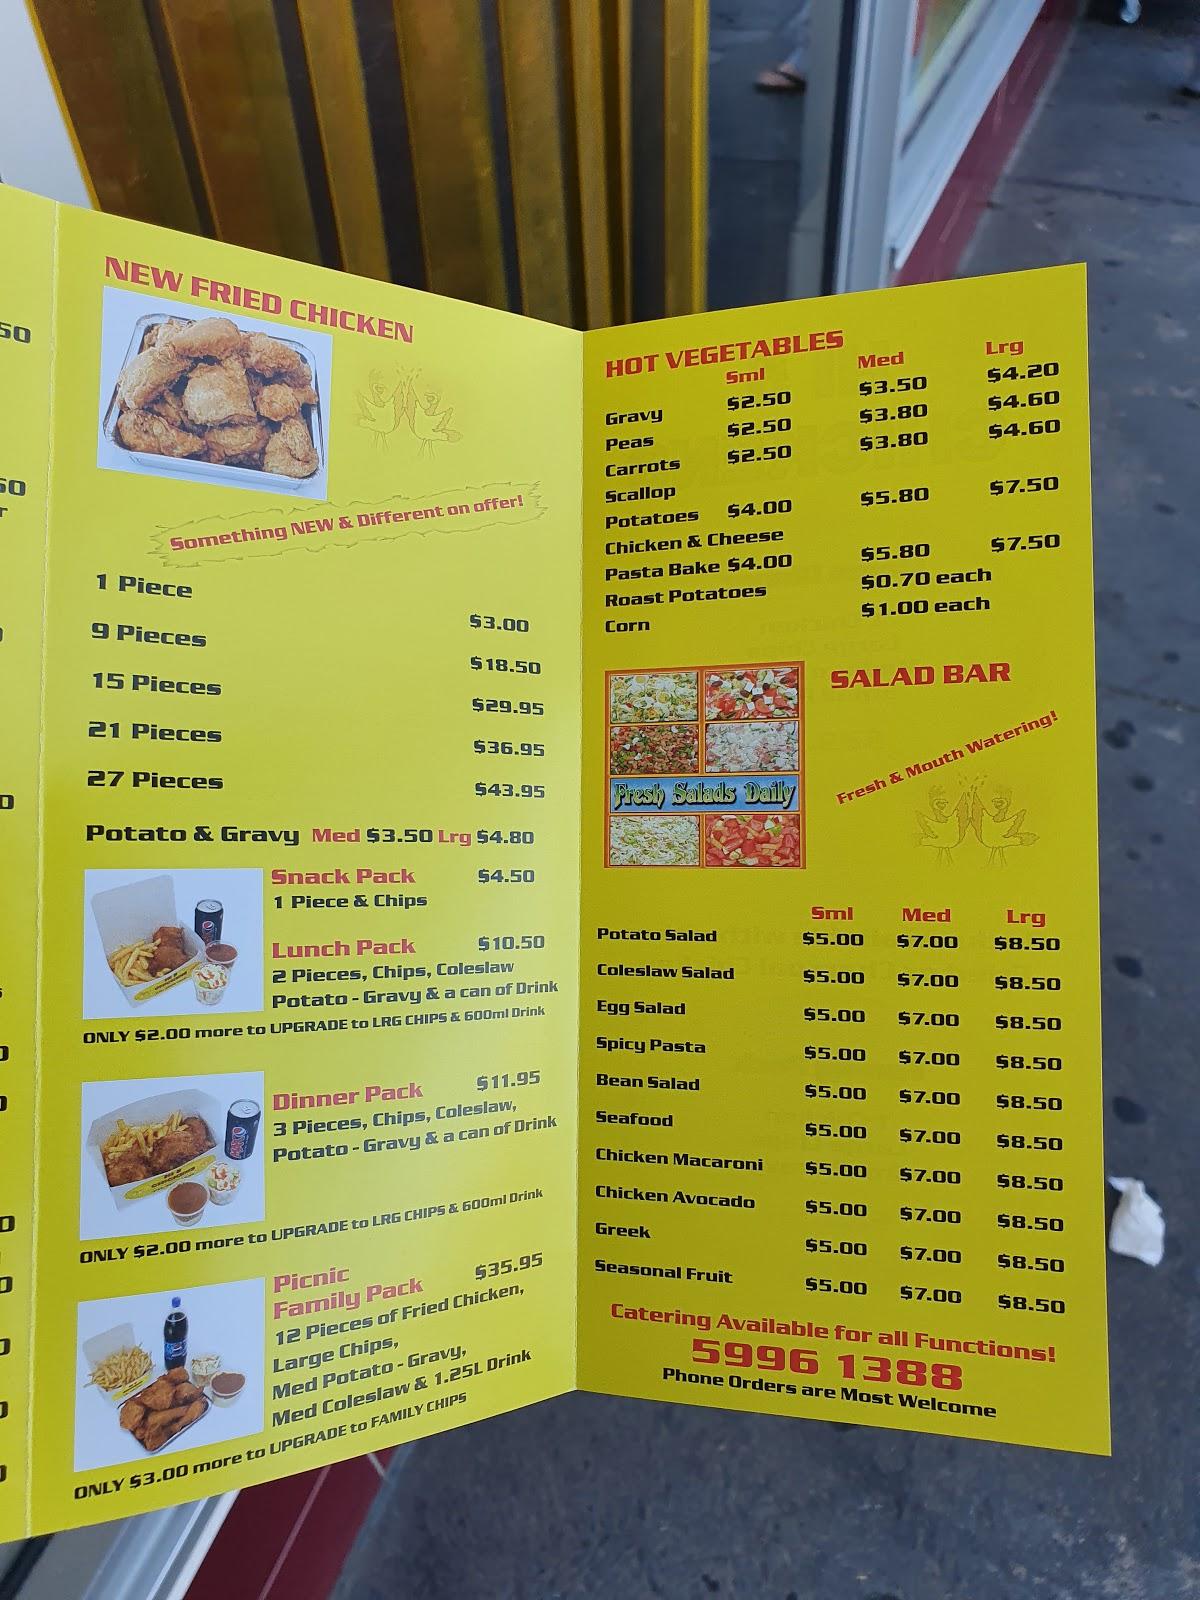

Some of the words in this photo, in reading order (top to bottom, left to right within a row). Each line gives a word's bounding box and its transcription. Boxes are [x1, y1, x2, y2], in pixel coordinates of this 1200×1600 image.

[105, 255, 184, 293] NEW
[190, 275, 282, 315] FRIED
[289, 299, 414, 344] CHICKEN
[606, 353, 660, 379] HOT
[664, 329, 844, 369] VEGETABLES
[985, 340, 1024, 356] Lrg
[857, 351, 905, 369] Med
[726, 367, 765, 385] Sml
[987, 362, 1060, 384] $4.20
[859, 376, 928, 397] $3.50
[727, 391, 792, 412] $2.50
[605, 409, 663, 426] Gravy
[605, 436, 654, 452] Peas
[605, 459, 681, 478] Carrots
[605, 486, 676, 504] Scallop
[989, 476, 1059, 497] $7.50
[860, 487, 930, 508] $5.80
[727, 499, 793, 519] $4.00
[170, 526, 288, 551] Something
[290, 518, 334, 536] NEW
[338, 516, 354, 530] &
[356, 506, 445, 528] Different
[447, 504, 471, 516] on
[473, 494, 524, 513] offer!
[605, 511, 699, 530] Potatoes
[605, 538, 683, 556] Chicken
[686, 534, 703, 549] &
[707, 530, 784, 547] Cheese
[605, 566, 664, 582] Pasta
[668, 561, 721, 577] Bake
[861, 571, 931, 591] $0.70
[935, 567, 992, 585] each
[96, 573, 107, 590] 1
[118, 575, 193, 599] Piece
[605, 591, 665, 608] Roast
[668, 586, 767, 603] Potatoes
[861, 599, 929, 618] $1.00
[934, 596, 991, 613] each
[469, 613, 529, 633] $3.00
[605, 619, 651, 633] Corn
[91, 622, 110, 640] 9
[116, 624, 207, 648] Pieces
[470, 655, 541, 675] $18.50
[830, 665, 935, 689] SALAD
[943, 662, 1012, 684] BAR
[835, 779, 887, 805] Fresh
[888, 771, 905, 785] &
[905, 749, 965, 778] Mouth
[964, 710, 1058, 754] Watering!
[87, 770, 125, 787] 27
[132, 771, 224, 790] Pieces
[474, 781, 545, 799] $43.95
[614, 782, 666, 810] Fresh
[672, 781, 737, 806] Salads
[744, 781, 796, 809] Daily
[86, 824, 187, 842] Potato
[193, 825, 215, 842] &
[220, 826, 300, 847] Gravy
[312, 828, 361, 843] Med
[366, 827, 434, 844] $3.50
[438, 829, 472, 847] Lrg
[476, 828, 535, 845] $4.80
[271, 868, 351, 885] Snack
[356, 868, 416, 884] Pack
[478, 868, 535, 884] $4.50
[478, 935, 545, 952] $10.50
[597, 927, 662, 941] Potato
[664, 929, 718, 943] Salad
[802, 931, 864, 947] $5.00
[896, 933, 959, 949] $7.00
[994, 935, 1061, 951] $8.50
[272, 940, 351, 959] Lunch
[356, 938, 416, 956] Pack
[597, 963, 679, 978] Coleslaw
[681, 965, 735, 980] Salad
[272, 993, 348, 1009] Potato
[363, 990, 422, 1005] Gravy
[425, 986, 441, 1000] &
[444, 989, 456, 999] a
[459, 987, 491, 998] can
[495, 982, 514, 996] of
[516, 980, 559, 995] Drink
[83, 1030, 131, 1044] ONLY
[134, 1027, 191, 1043] $2.00
[195, 1027, 244, 1039] more
[246, 1025, 267, 1036] to
[270, 1018, 349, 1034] UPGRADE
[350, 1019, 369, 1029] to
[372, 1015, 402, 1028] LRG
[405, 1012, 448, 1026] CHIPS
[450, 1011, 461, 1023] &
[464, 1008, 509, 1021] 600ml
[511, 1005, 546, 1018] Drink
[596, 1036, 646, 1054] Spicy
[649, 1038, 706, 1054] Pasta
[476, 1070, 541, 1092] $11.95
[272, 1091, 360, 1111] Dinner
[365, 1082, 424, 1103] Pack
[804, 1083, 867, 1101] $5.00
[899, 1088, 961, 1106] $7.00
[996, 1093, 1063, 1111] $8.50
[273, 1122, 287, 1137] 3
[292, 1118, 368, 1135] Pieces,
[372, 1110, 431, 1127] Chips,
[435, 1100, 517, 1120] Coleslaw,
[595, 1110, 674, 1127] Seafood
[595, 1147, 669, 1165] Chicken
[673, 1152, 764, 1171] Macaroni
[595, 1222, 651, 1239] Greek
[475, 1252, 543, 1281] $35.95
[594, 1259, 682, 1280] Seasonal
[686, 1267, 734, 1284] Fruit
[273, 1267, 350, 1294] Picnic
[805, 1276, 868, 1296] $5.00
[273, 1291, 361, 1320] Family
[366, 1277, 424, 1303] Pack
[900, 1285, 962, 1304] $7.00
[998, 1293, 1066, 1314] $8.50
[275, 1327, 301, 1346] 12
[305, 1316, 374, 1340] Pieces
[377, 1308, 399, 1325] of
[402, 1297, 449, 1321] Fried
[453, 1284, 525, 1309] Chicken,
[611, 1303, 711, 1332] Catering
[715, 1313, 829, 1339] Available
[833, 1324, 873, 1343] for
[878, 1330, 909, 1347] all
[914, 1332, 1056, 1363] Functions!
[692, 1338, 819, 1375] 5996
[837, 1354, 963, 1391] 1388
[272, 1402, 318, 1428] Med
[322, 1382, 411, 1415] Coleslaw
[414, 1375, 429, 1391] &
[434, 1361, 484, 1386] 1.25L
[486, 1349, 532, 1372] Drink
[662, 1367, 725, 1387] Phone
[728, 1374, 797, 1395] Orders
[801, 1385, 837, 1399] are
[840, 1386, 895, 1406] Most
[897, 1393, 997, 1418] Welcome
[74, 1477, 125, 1500] ONLY
[129, 1464, 189, 1489] $3.00
[192, 1454, 243, 1475] more
[245, 1450, 266, 1461] to
[269, 1424, 347, 1455] UPGRADE
[349, 1421, 368, 1434] to
[371, 1403, 424, 1429] FAMILY
[426, 1392, 467, 1413] CHIPS
